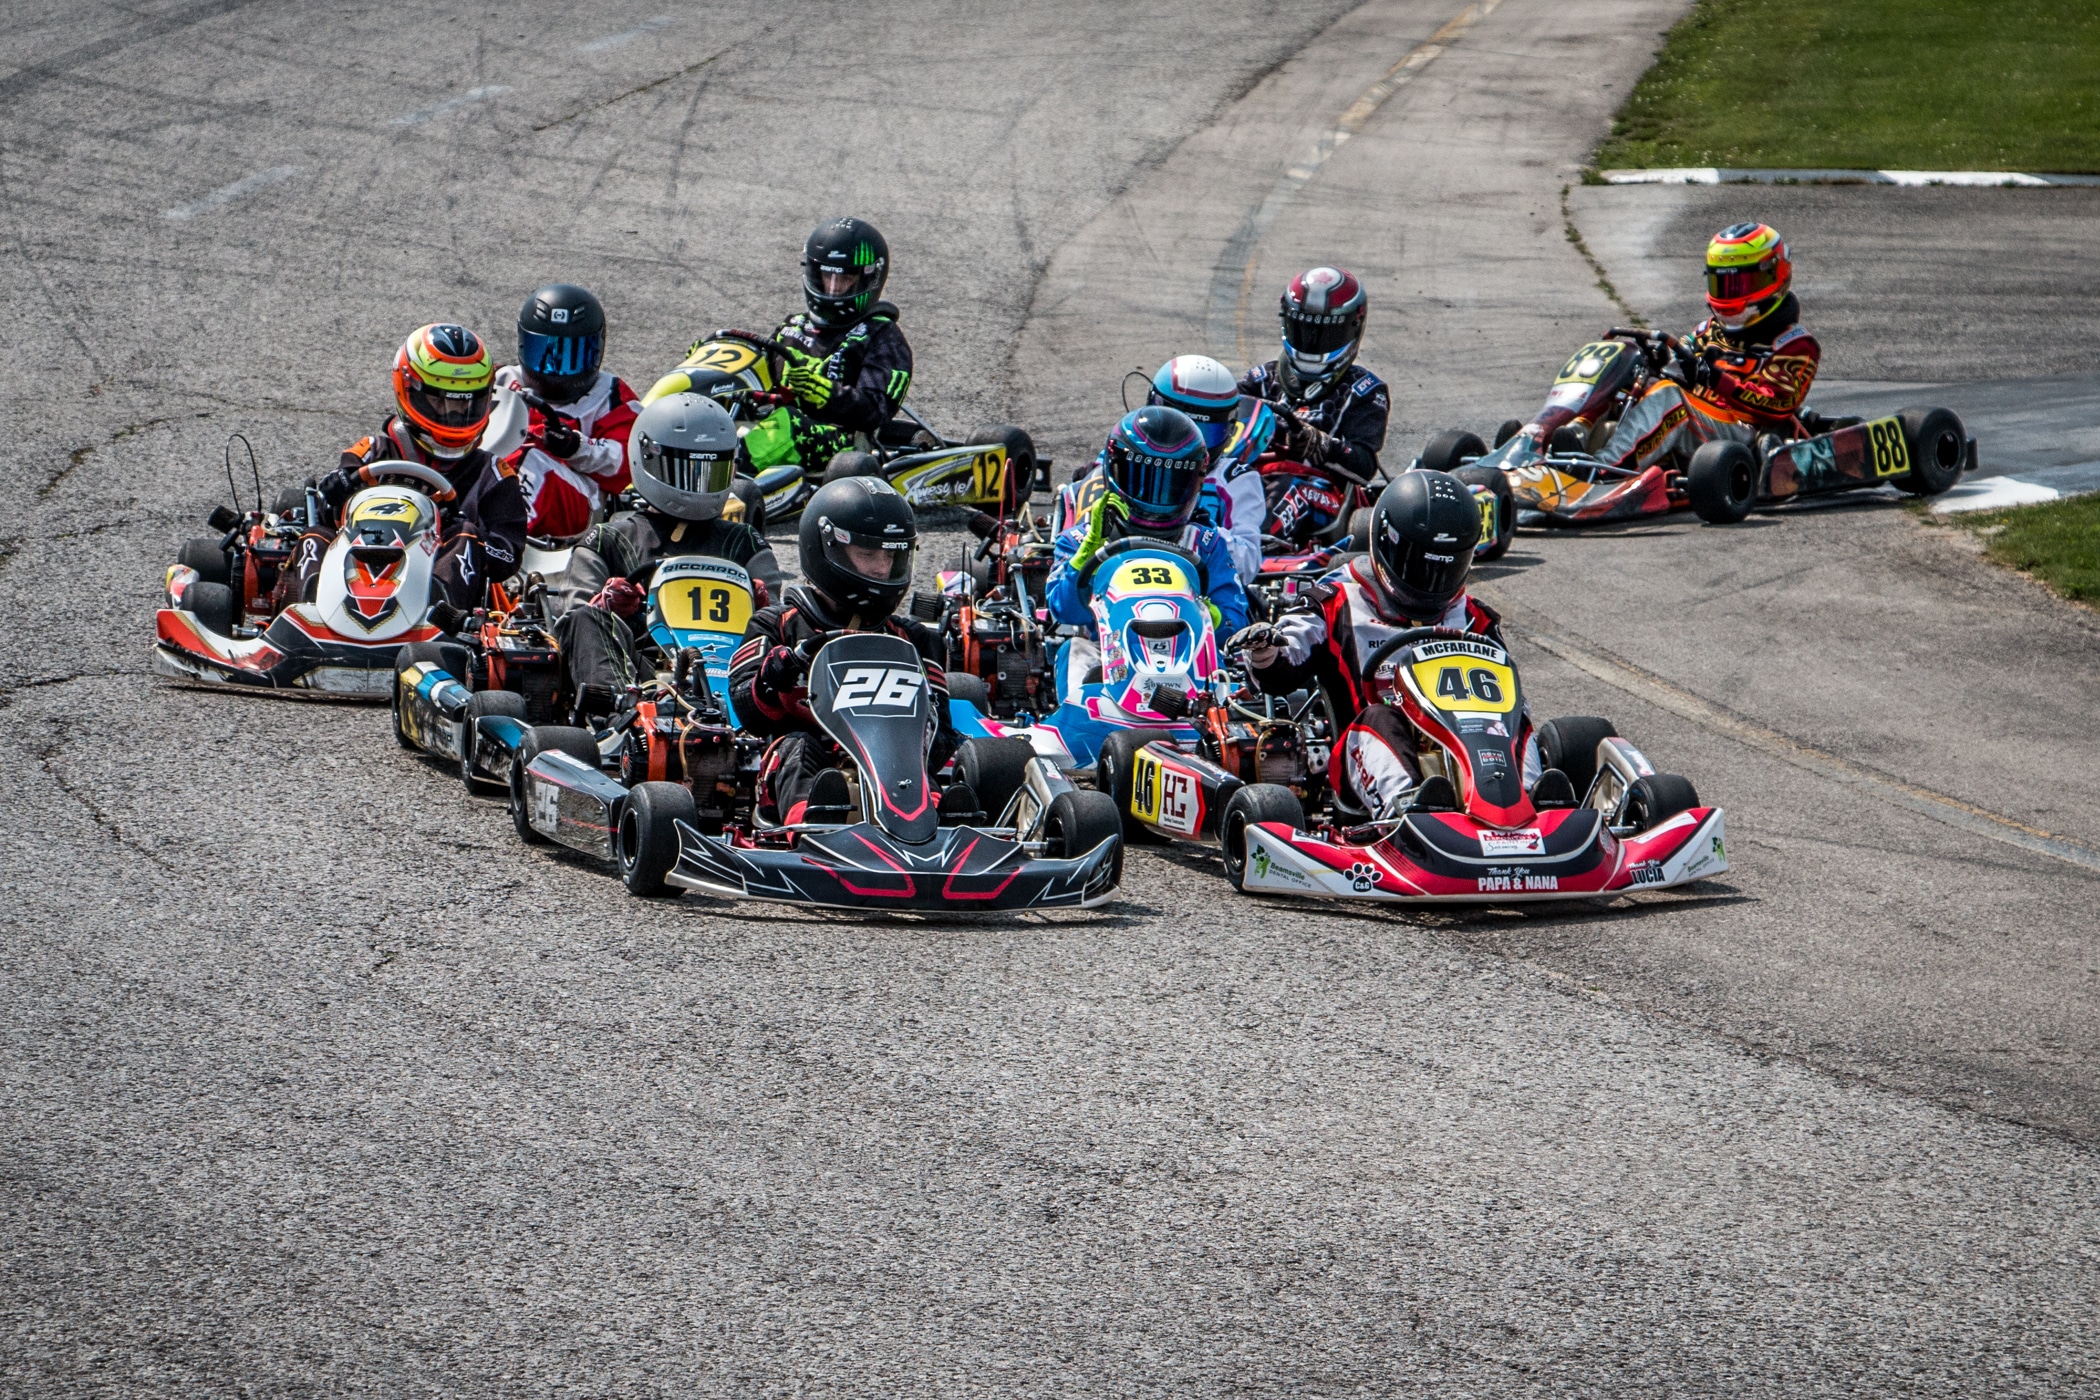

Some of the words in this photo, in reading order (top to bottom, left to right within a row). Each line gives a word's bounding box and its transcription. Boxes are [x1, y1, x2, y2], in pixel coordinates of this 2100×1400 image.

[820, 265, 843, 274] zamp
[694, 349, 742, 369] 12
[445, 392, 473, 400] zamp
[1872, 420, 1907, 473] 88
[1126, 451, 1196, 471] RaceQuip
[974, 452, 1001, 498] 12
[363, 502, 409, 516] 4
[881, 541, 908, 550] zamp
[1424, 552, 1454, 563] zamp
[662, 563, 748, 580] RICCIARDO
[1131, 566, 1172, 585] 33
[687, 586, 730, 623] 13
[1422, 642, 1498, 659] MCFARLANE
[832, 668, 924, 713] 26
[1436, 666, 1503, 704] 46
[1134, 757, 1156, 817] 46
[1268, 870, 1290, 881] DENTAL
[1291, 877, 1312, 889] OFFICE
[1270, 862, 1306, 881] Beamsville
[1487, 866, 1511, 876] Thank
[1514, 866, 1531, 879] You
[1631, 867, 1666, 885] LUCIA
[1354, 881, 1370, 890] C&G
[1478, 877, 1511, 891] PAPA
[1513, 878, 1523, 890] &
[1525, 875, 1558, 890] NANA
